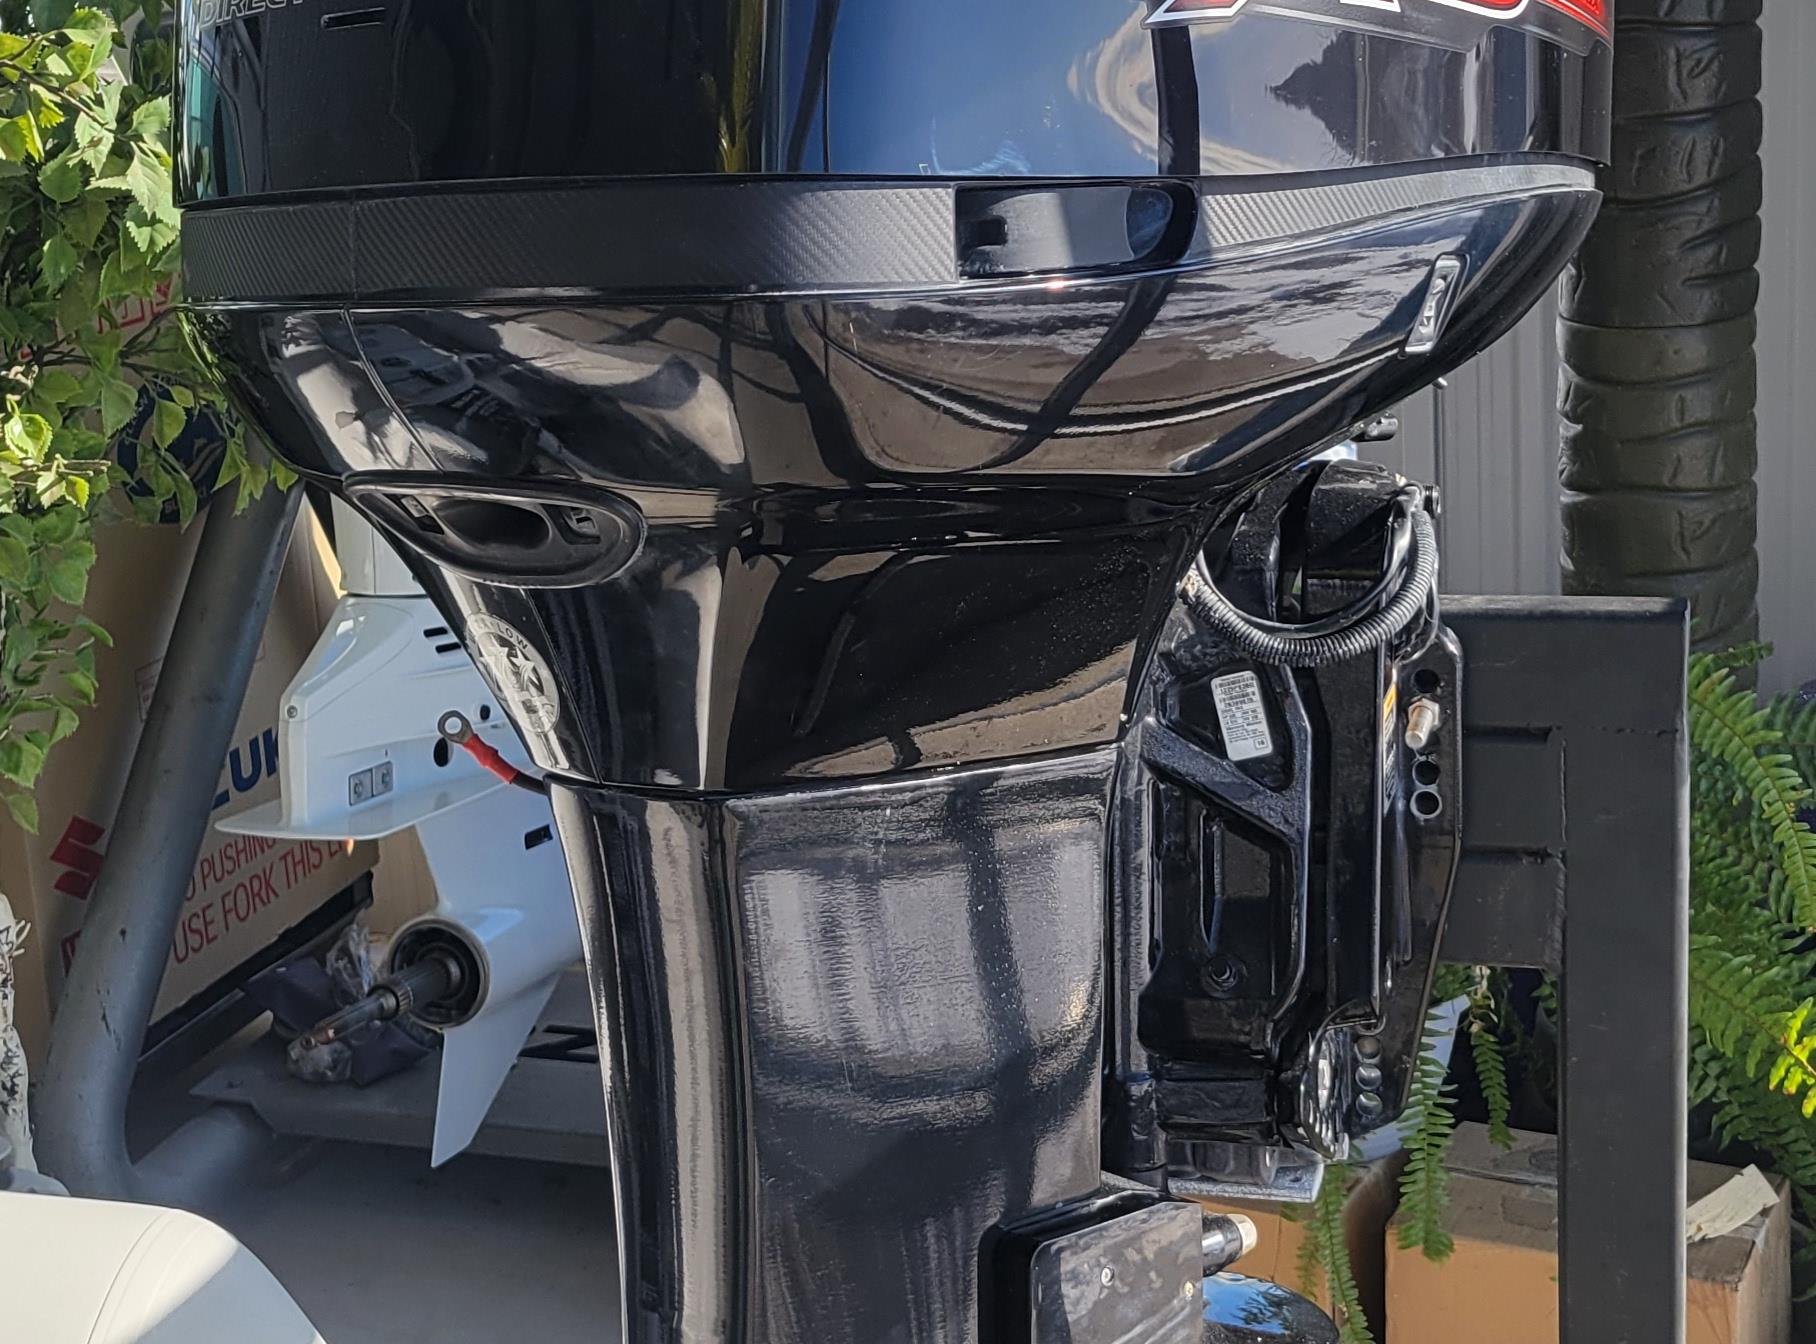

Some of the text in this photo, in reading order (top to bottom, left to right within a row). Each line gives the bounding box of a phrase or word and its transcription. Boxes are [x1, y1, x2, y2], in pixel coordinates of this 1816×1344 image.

[172, 902, 219, 965] USE
[220, 869, 281, 933] FORK
[279, 839, 323, 891] THIS
